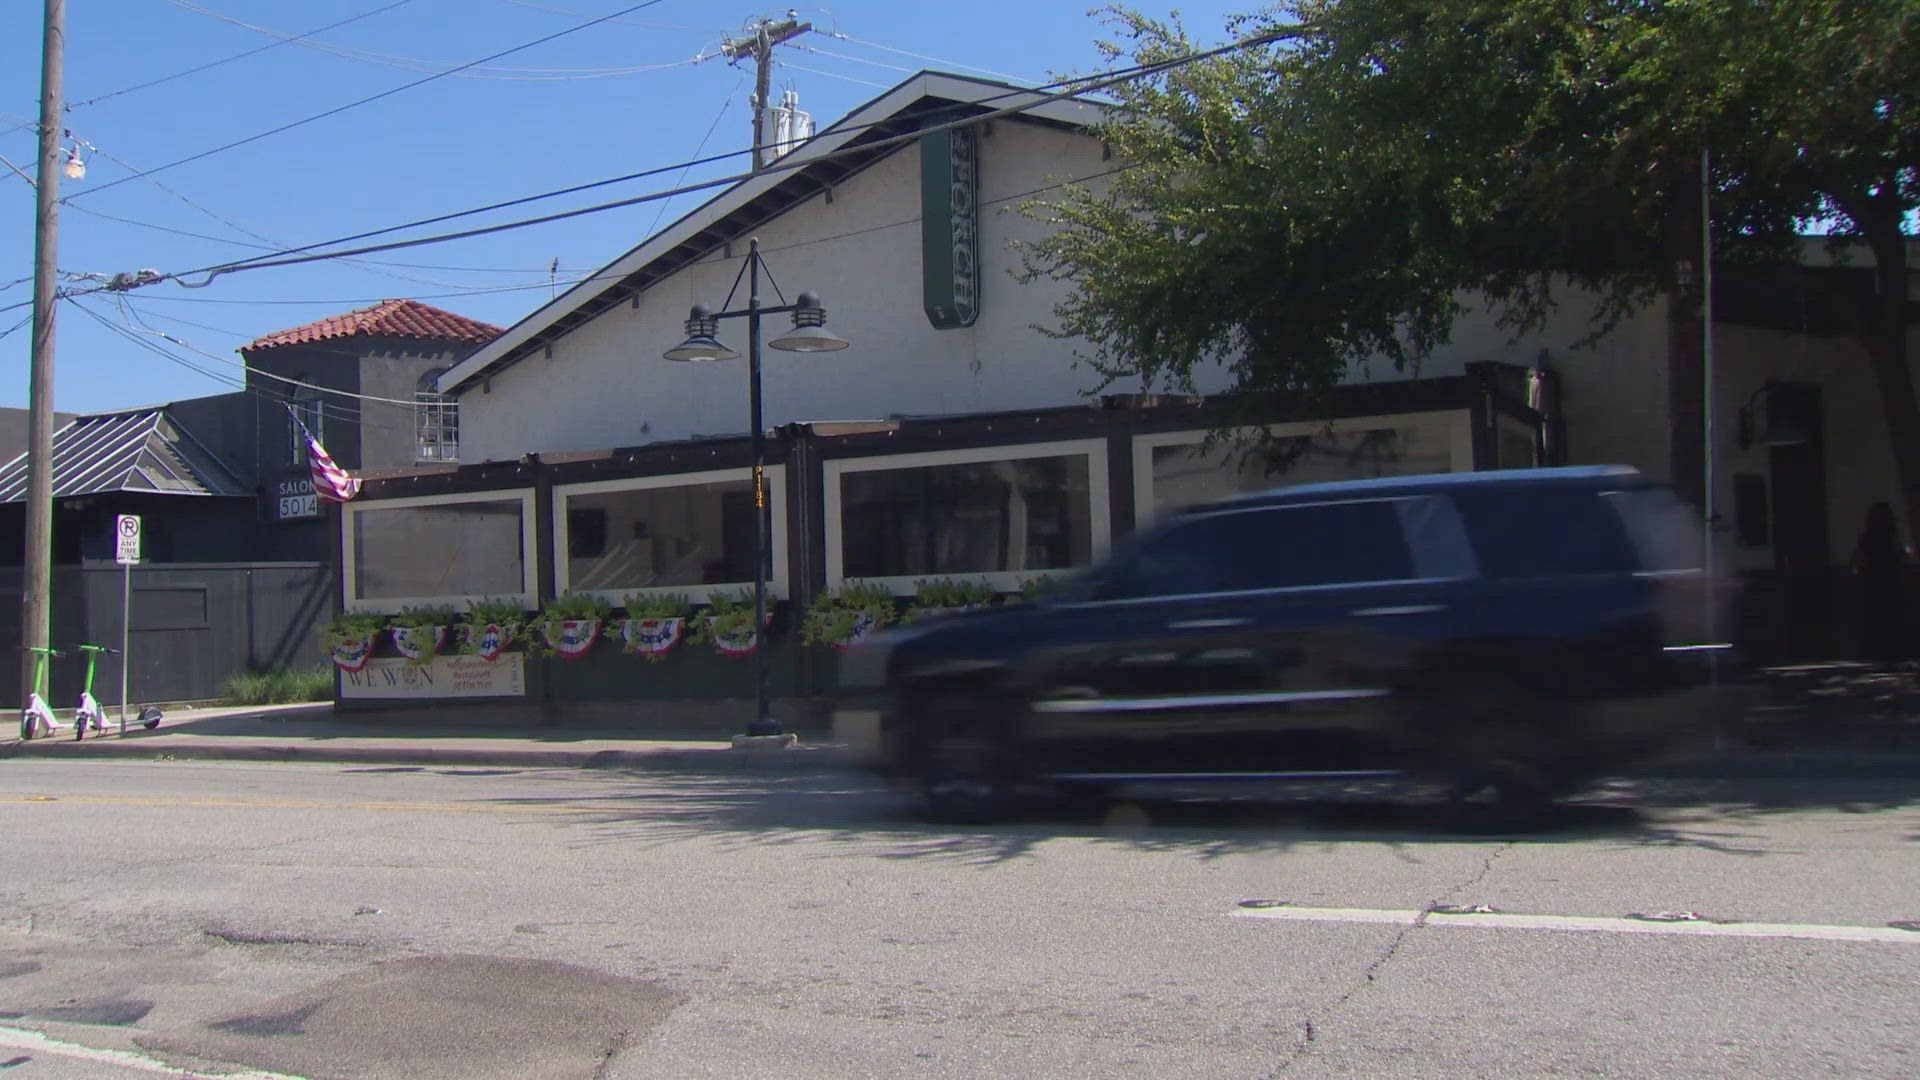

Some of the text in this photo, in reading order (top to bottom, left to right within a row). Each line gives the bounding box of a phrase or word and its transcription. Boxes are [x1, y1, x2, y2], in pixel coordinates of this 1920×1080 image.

[281, 497, 316, 516] 5014
[348, 666, 434, 687] WE WN
